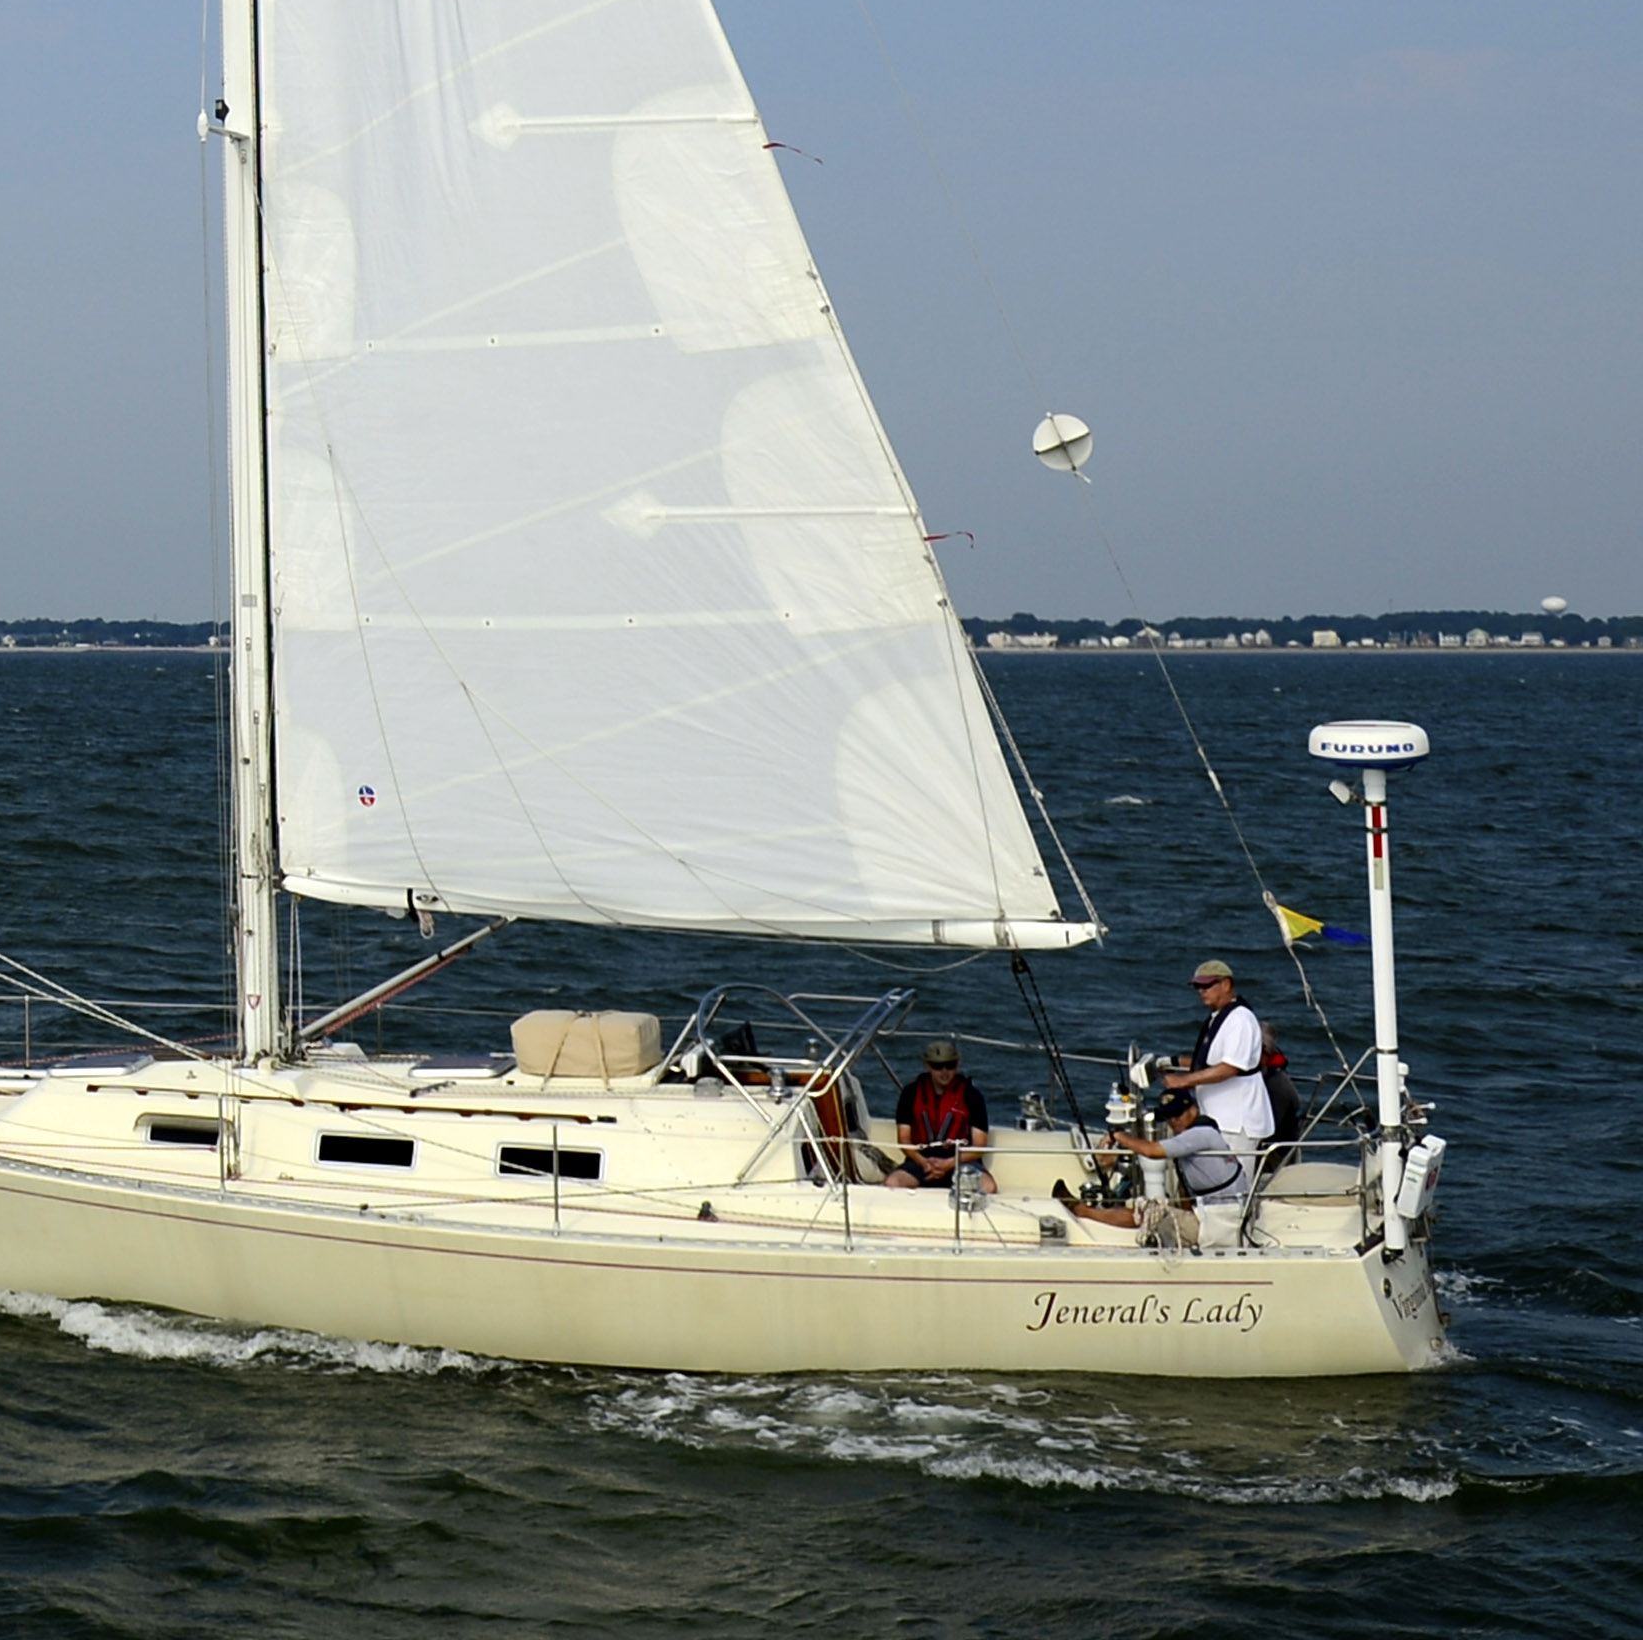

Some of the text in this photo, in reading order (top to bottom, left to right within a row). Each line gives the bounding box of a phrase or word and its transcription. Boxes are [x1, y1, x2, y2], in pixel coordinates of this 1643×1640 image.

[1321, 742, 1414, 753] FURUNO
[1026, 1291, 1263, 1333] Jeneral's Lady
